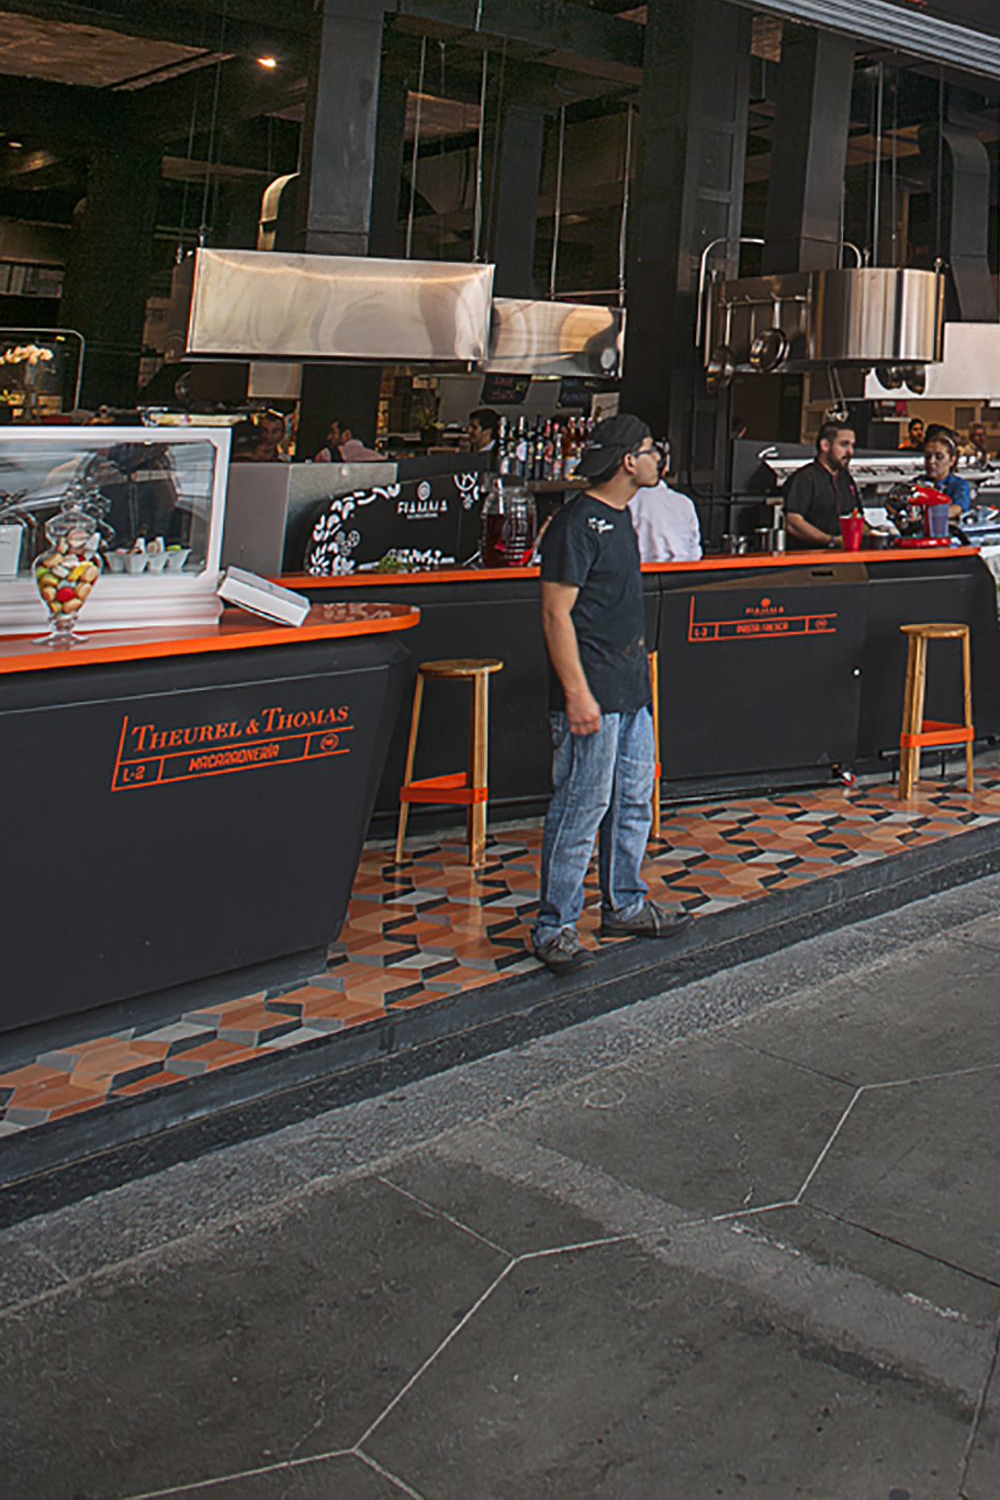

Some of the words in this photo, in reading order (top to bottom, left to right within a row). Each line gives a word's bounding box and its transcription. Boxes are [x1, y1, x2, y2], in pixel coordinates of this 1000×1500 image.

[131, 722, 242, 752] THEUREL
[245, 718, 260, 736] &
[261, 705, 349, 732] THOMAS
